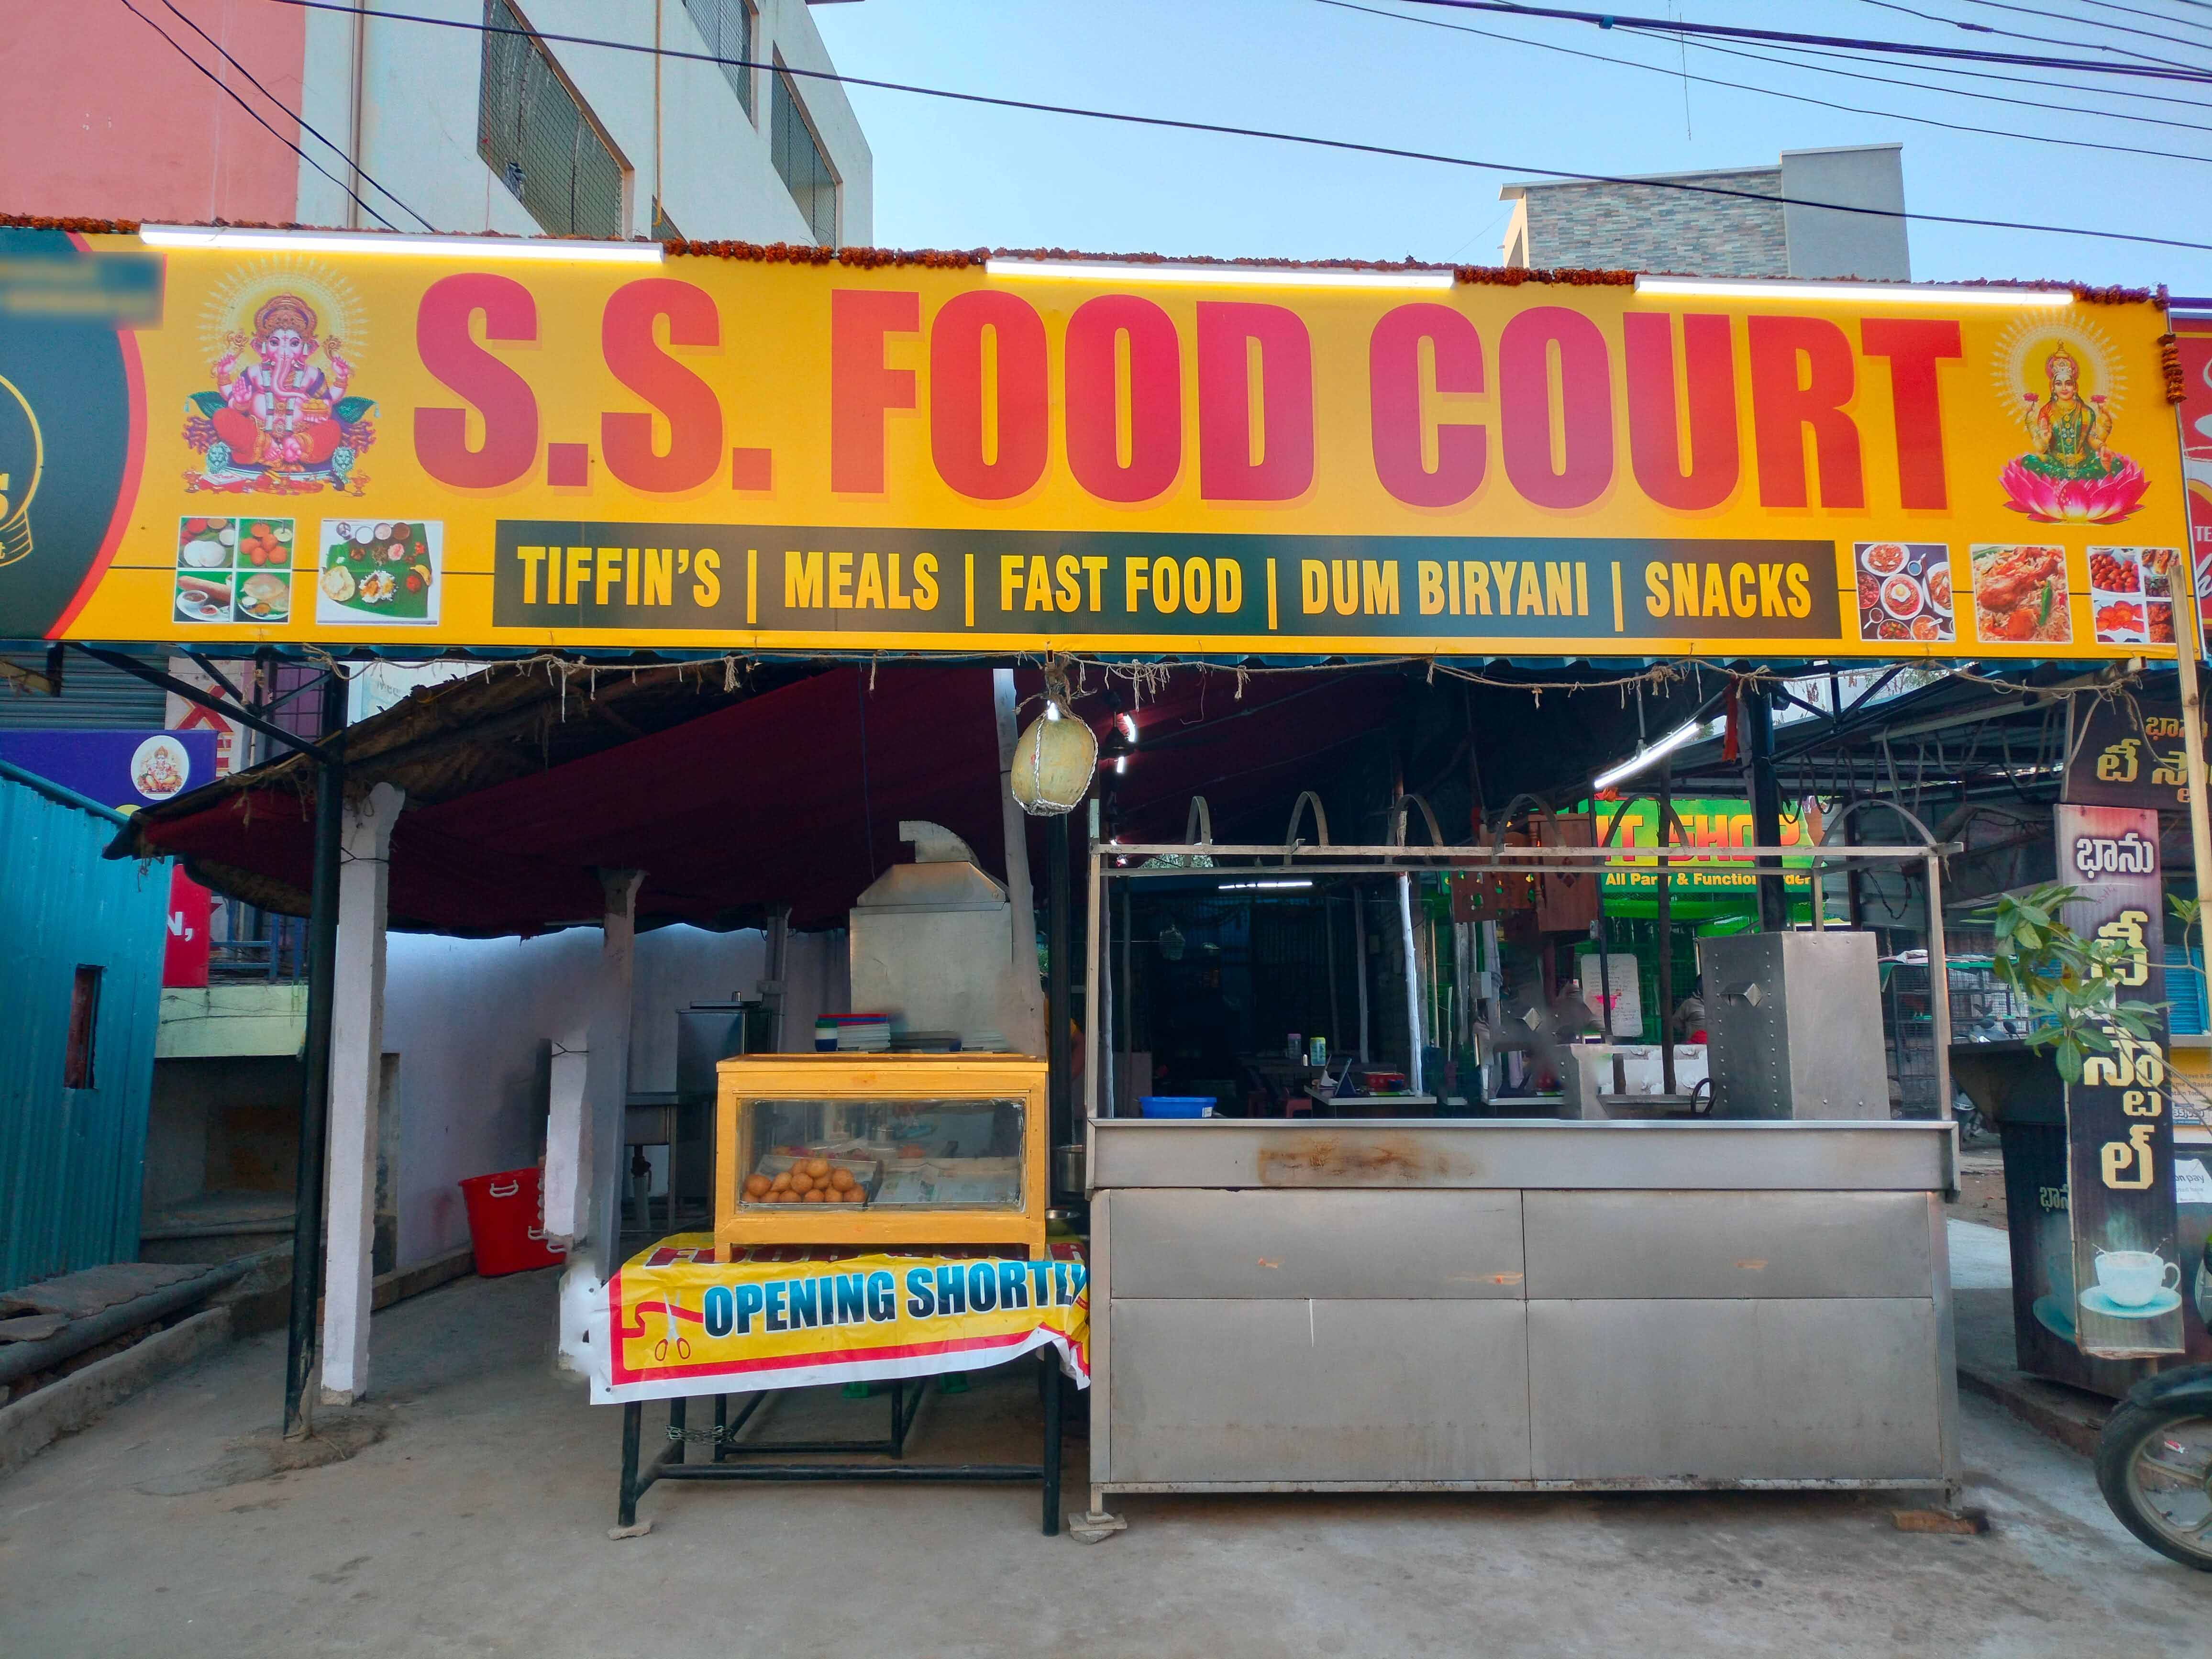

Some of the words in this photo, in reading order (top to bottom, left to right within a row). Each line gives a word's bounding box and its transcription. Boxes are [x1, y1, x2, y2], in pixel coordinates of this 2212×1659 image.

[414, 272, 772, 493] S.S.
[831, 289, 1315, 503] FOOD
[1369, 302, 1962, 511] COURT
[785, 551, 939, 611] MEALS
[1001, 554, 1107, 612] FAST
[1126, 556, 1243, 615] FOOD
[1302, 559, 1400, 616] DUM
[1418, 560, 1589, 616] BIRYANI
[1645, 563, 1812, 619] SNACKS
[1605, 873, 1626, 885] All
[1677, 873, 1689, 885] &
[2076, 832, 2154, 879] భాను
[703, 1271, 896, 1338] OPENING
[906, 1260, 1087, 1318] SHORTLY
